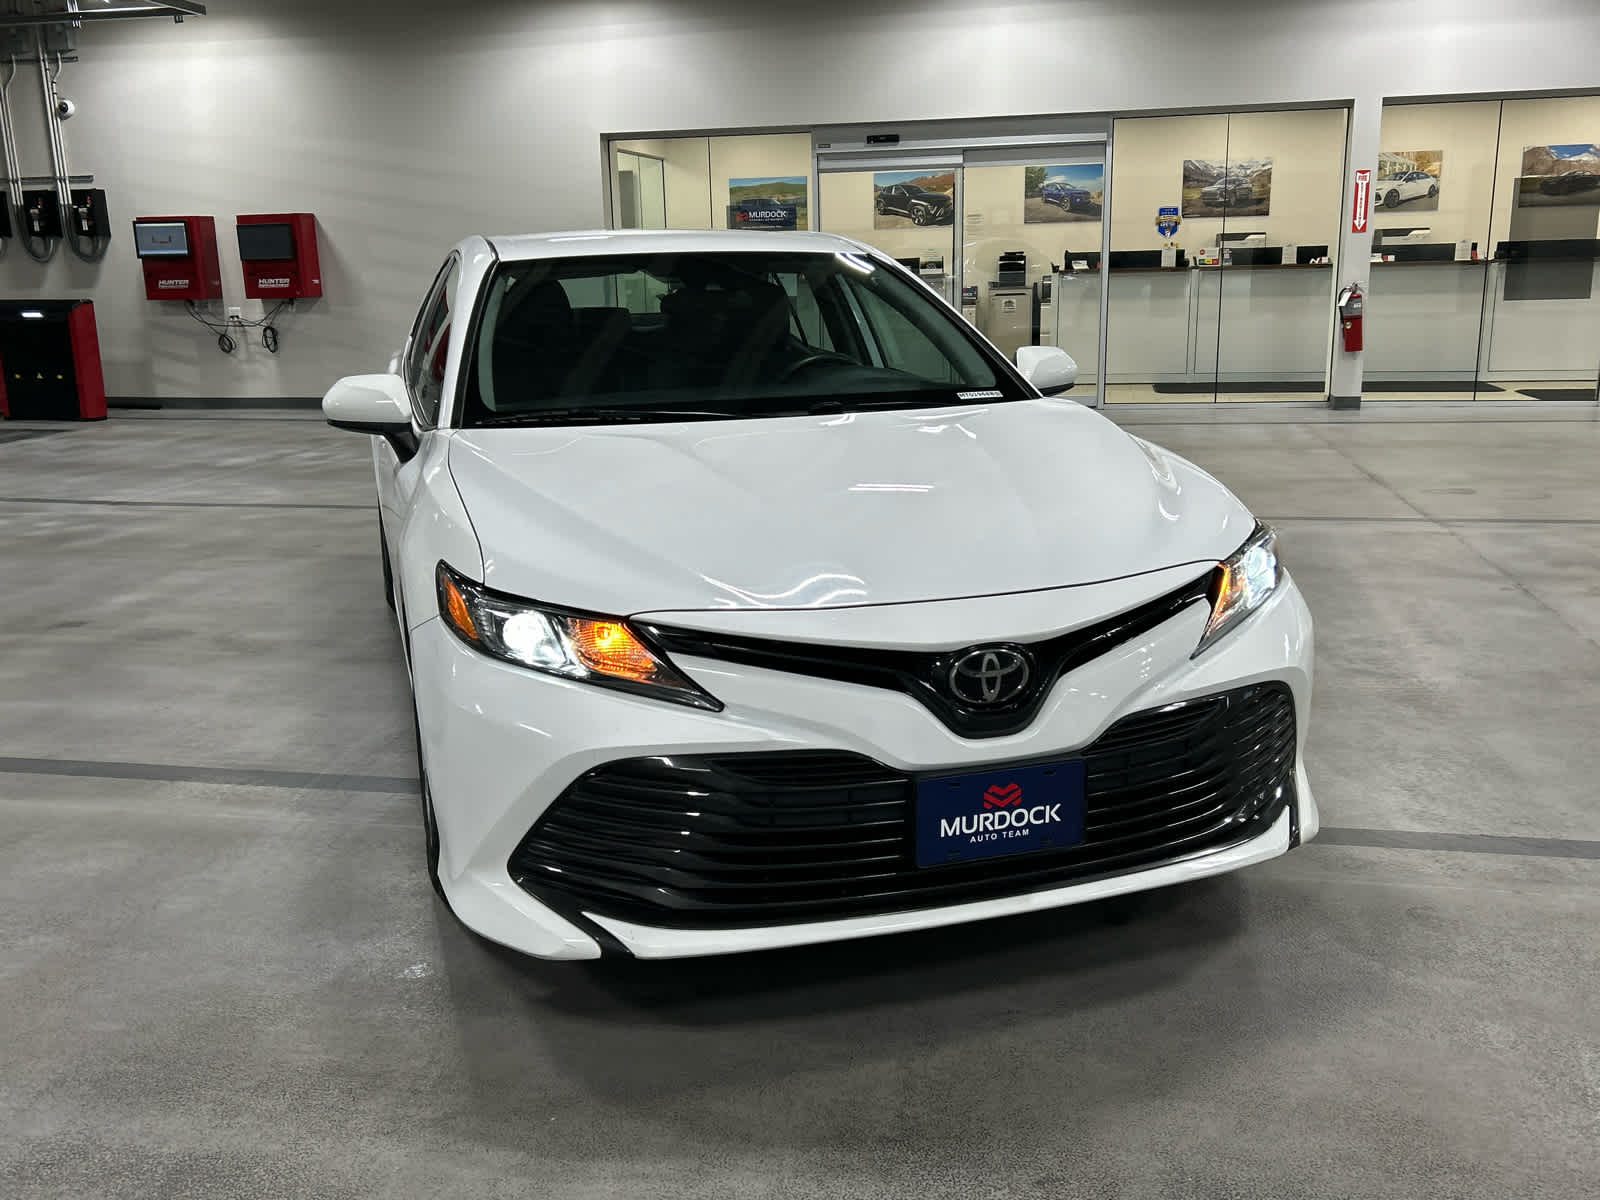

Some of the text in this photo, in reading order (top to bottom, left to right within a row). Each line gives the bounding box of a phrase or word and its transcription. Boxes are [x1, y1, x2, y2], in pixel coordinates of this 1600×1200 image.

[748, 210, 787, 219] MURDOCK
[940, 803, 1062, 838] MURDOCK
[969, 828, 1030, 844] AUTO TEAM
